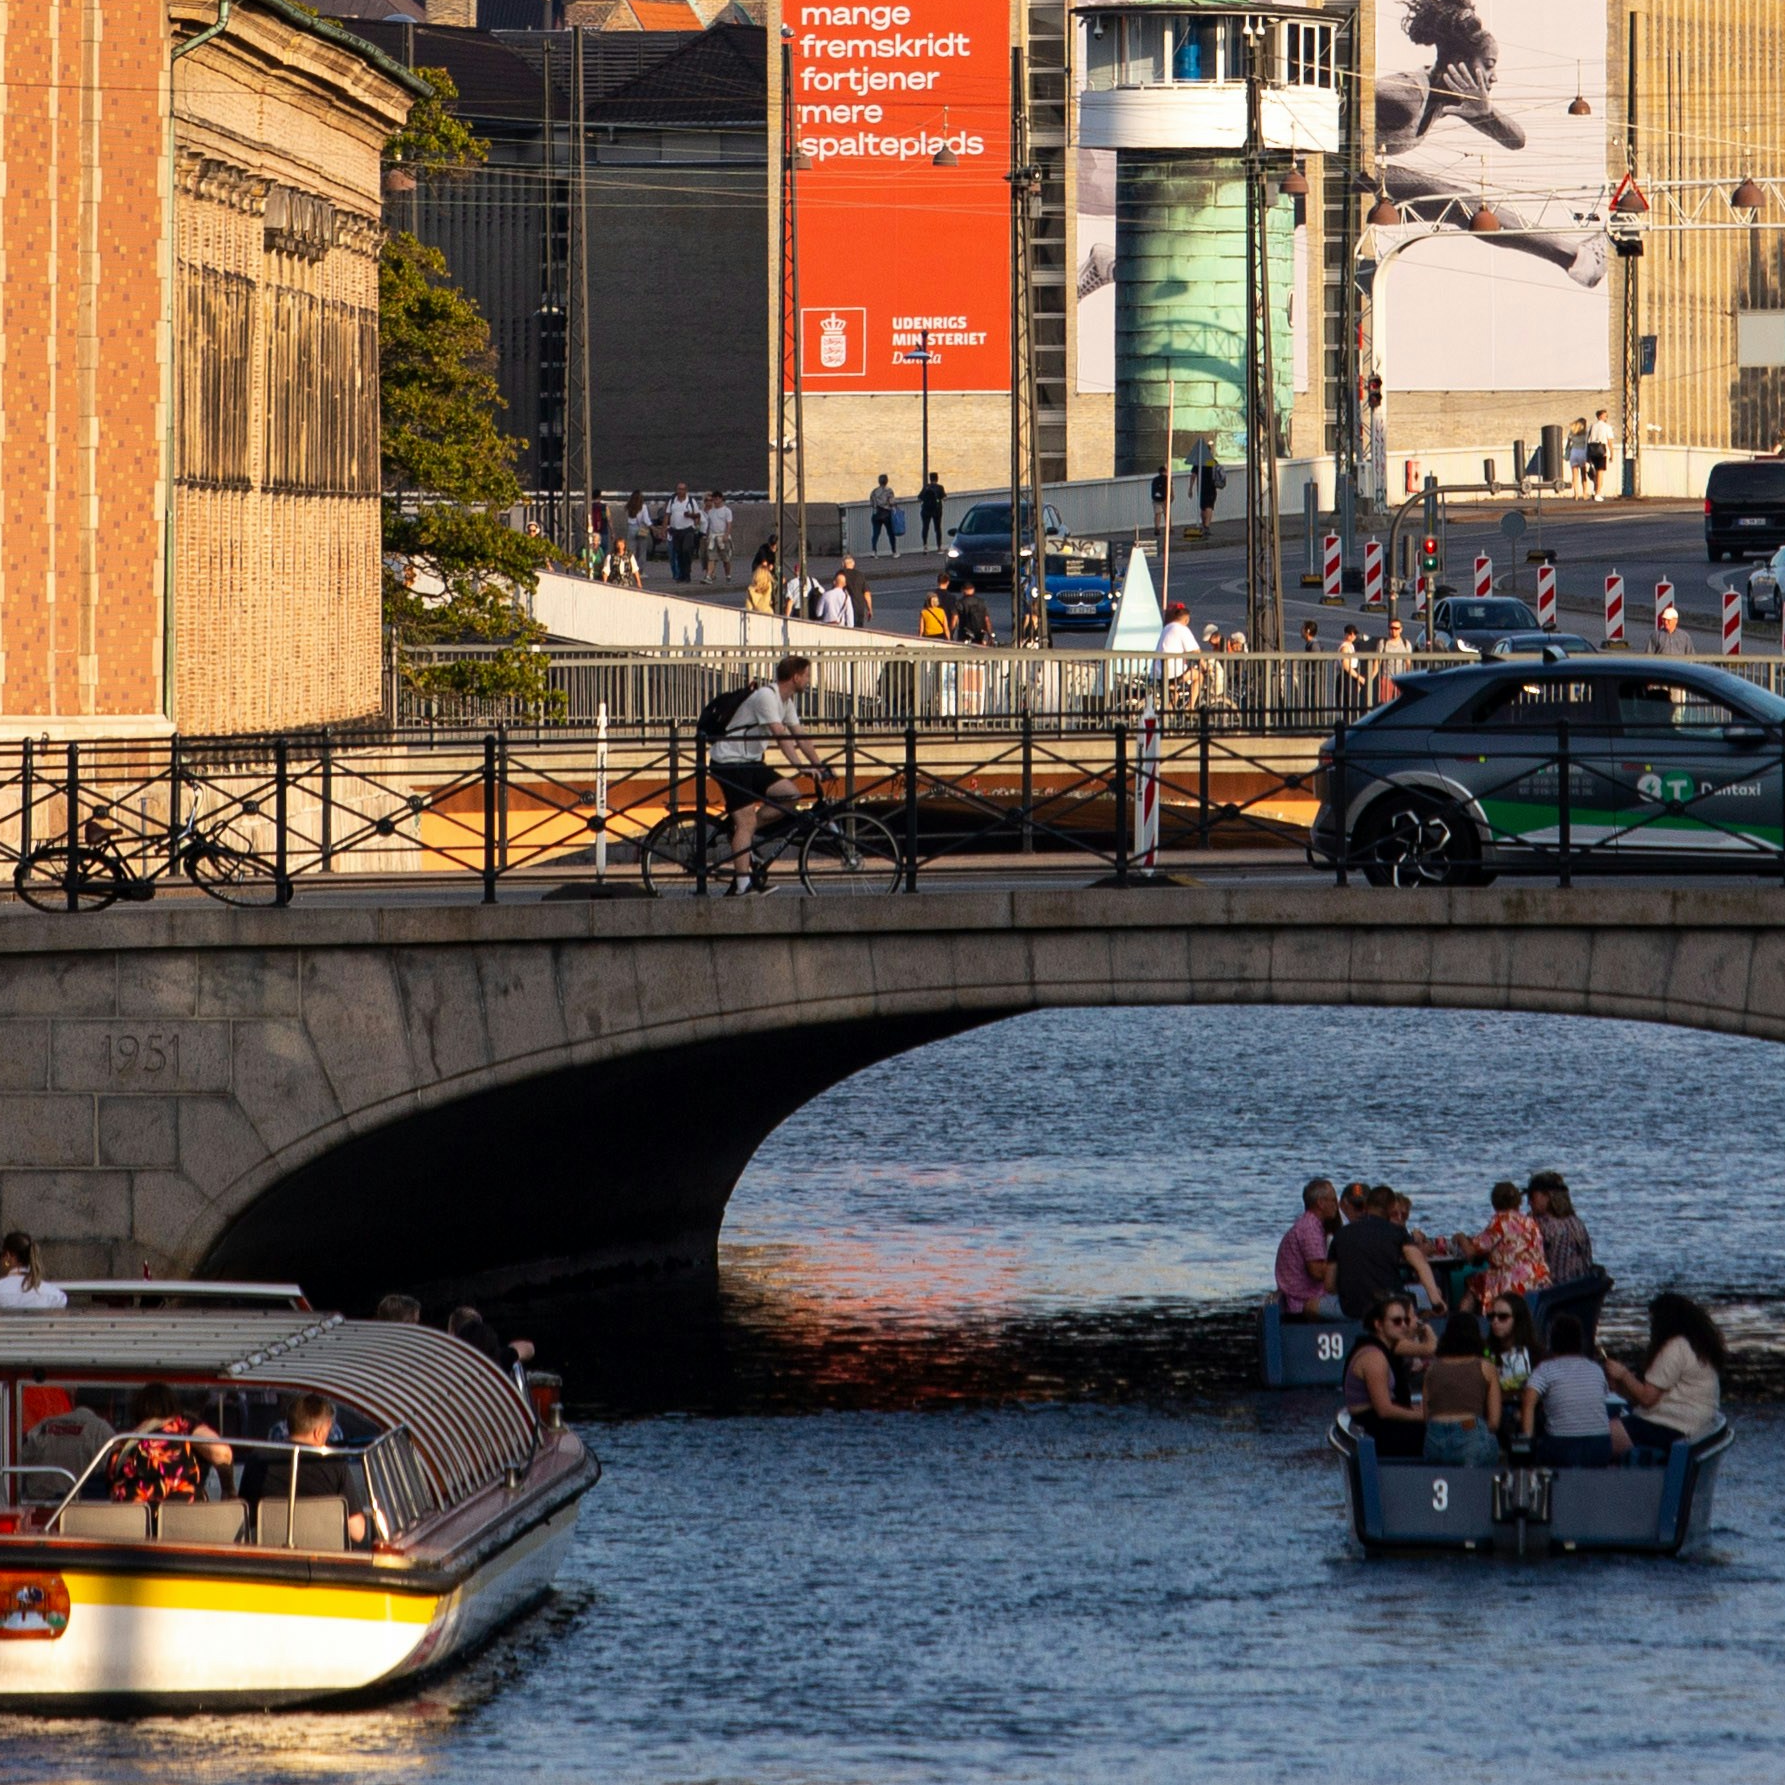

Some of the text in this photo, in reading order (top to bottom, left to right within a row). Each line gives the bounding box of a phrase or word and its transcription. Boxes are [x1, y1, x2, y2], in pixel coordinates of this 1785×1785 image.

[801, 5, 912, 31] mange
[800, 32, 971, 58] fremskridt
[800, 66, 941, 96] fortjener
[801, 104, 884, 124] mere
[800, 131, 985, 162] spalteplads
[892, 316, 968, 330] UDENRIGS
[892, 332, 988, 346] MINSTERIET
[891, 350, 942, 365] Dda
[1666, 780, 1688, 800] T
[102, 1033, 182, 1076] 1951
[1317, 1333, 1344, 1361] 39
[1432, 1479, 1449, 1511] 3
